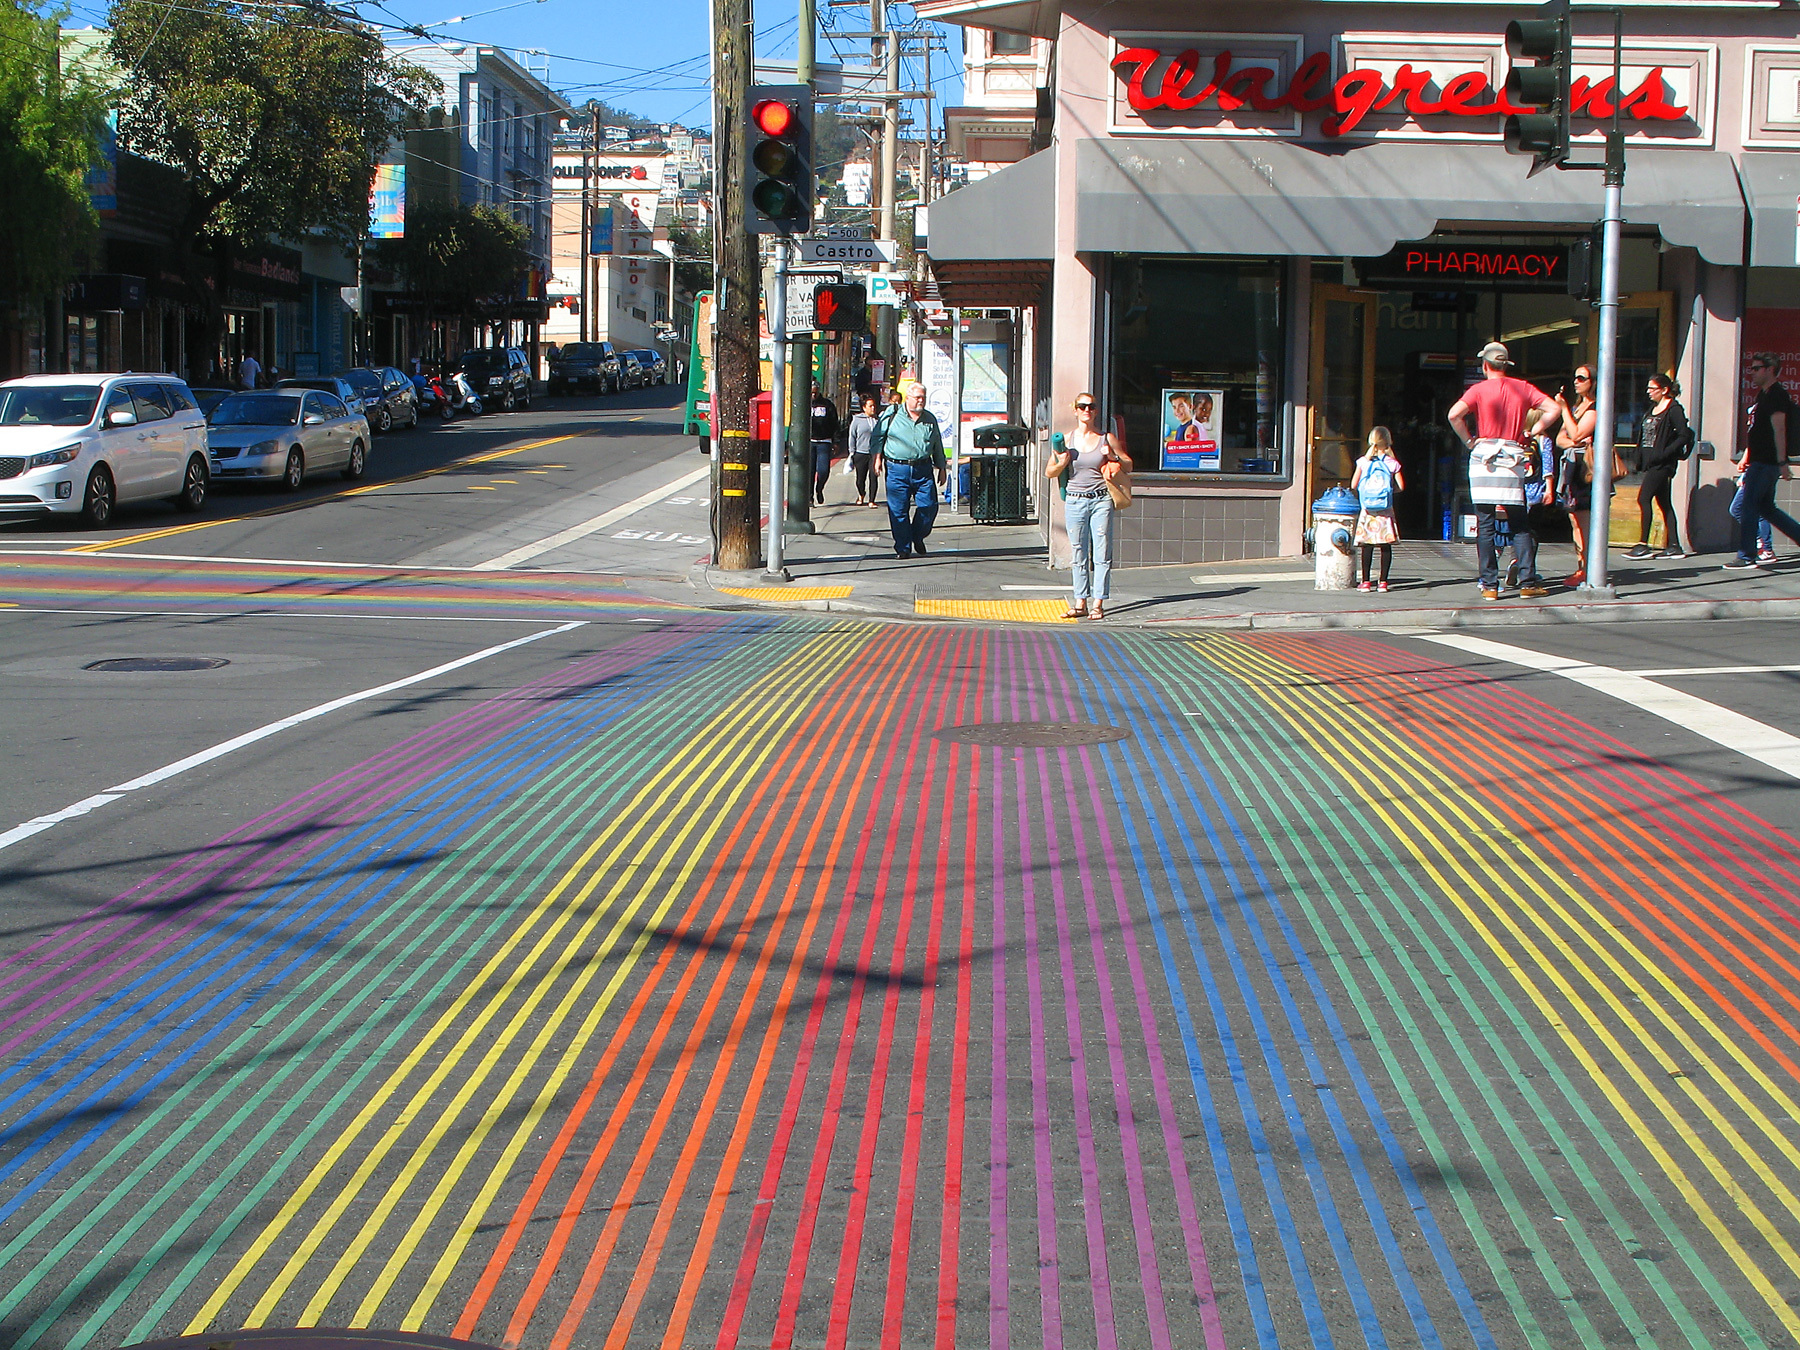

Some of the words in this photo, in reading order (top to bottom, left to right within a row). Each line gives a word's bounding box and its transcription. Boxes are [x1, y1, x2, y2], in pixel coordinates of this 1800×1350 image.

[1110, 47, 1688, 137] Walgrens
[630, 197, 640, 284] CASTRO
[840, 229, 859, 238] 500
[815, 244, 873, 258] Castro
[1406, 251, 1560, 276] PHARMACY
[1785, 364, 1797, 376] in
[610, 529, 711, 544] BUS
